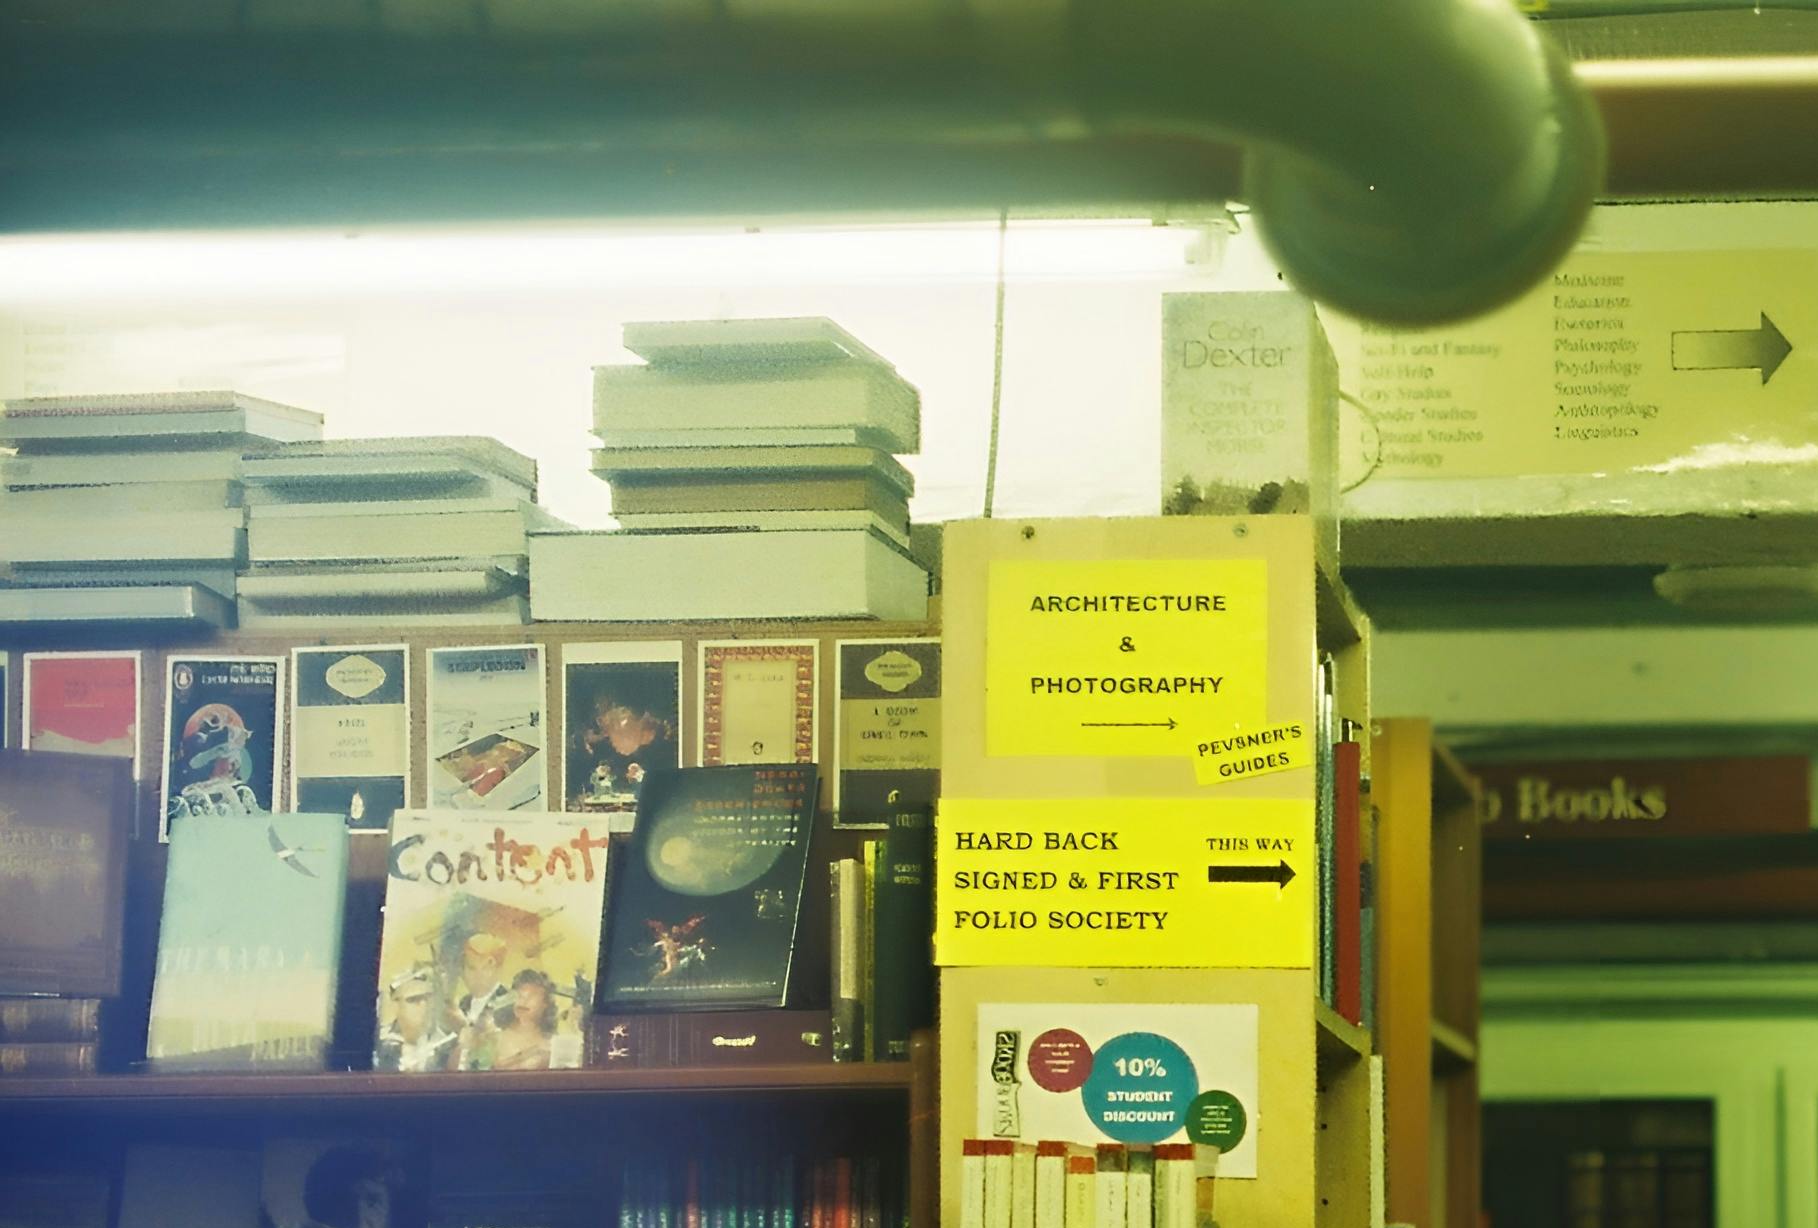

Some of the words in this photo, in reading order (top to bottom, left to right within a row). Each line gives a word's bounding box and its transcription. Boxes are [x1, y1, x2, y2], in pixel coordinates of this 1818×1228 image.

[1208, 319, 1265, 341] Colin
[1183, 340, 1293, 370] Dexter
[1030, 595, 1227, 613] ARCHITECTURE
[1119, 635, 1136, 653] &
[1030, 676, 1224, 694] PHOTOGRAPHY
[1197, 724, 1302, 758] PEVSNER'S
[1219, 751, 1290, 778] GUIDES
[1517, 775, 1669, 821] Books
[954, 831, 1034, 851] HARD
[1044, 831, 1120, 851] BACK
[1206, 837, 1250, 852] THIS
[1256, 837, 1296, 852] WAY
[389, 826, 609, 885] Content
[954, 871, 1058, 890] SIGNED
[1068, 872, 1089, 890] &
[1097, 871, 1180, 890] FIRST
[954, 911, 1038, 930] FOLIO
[1048, 911, 1169, 930] SOCIETY
[1113, 1057, 1167, 1078] 10%
[1106, 1090, 1173, 1102] STUDENT
[1103, 1110, 1175, 1122] DISCOUNT
